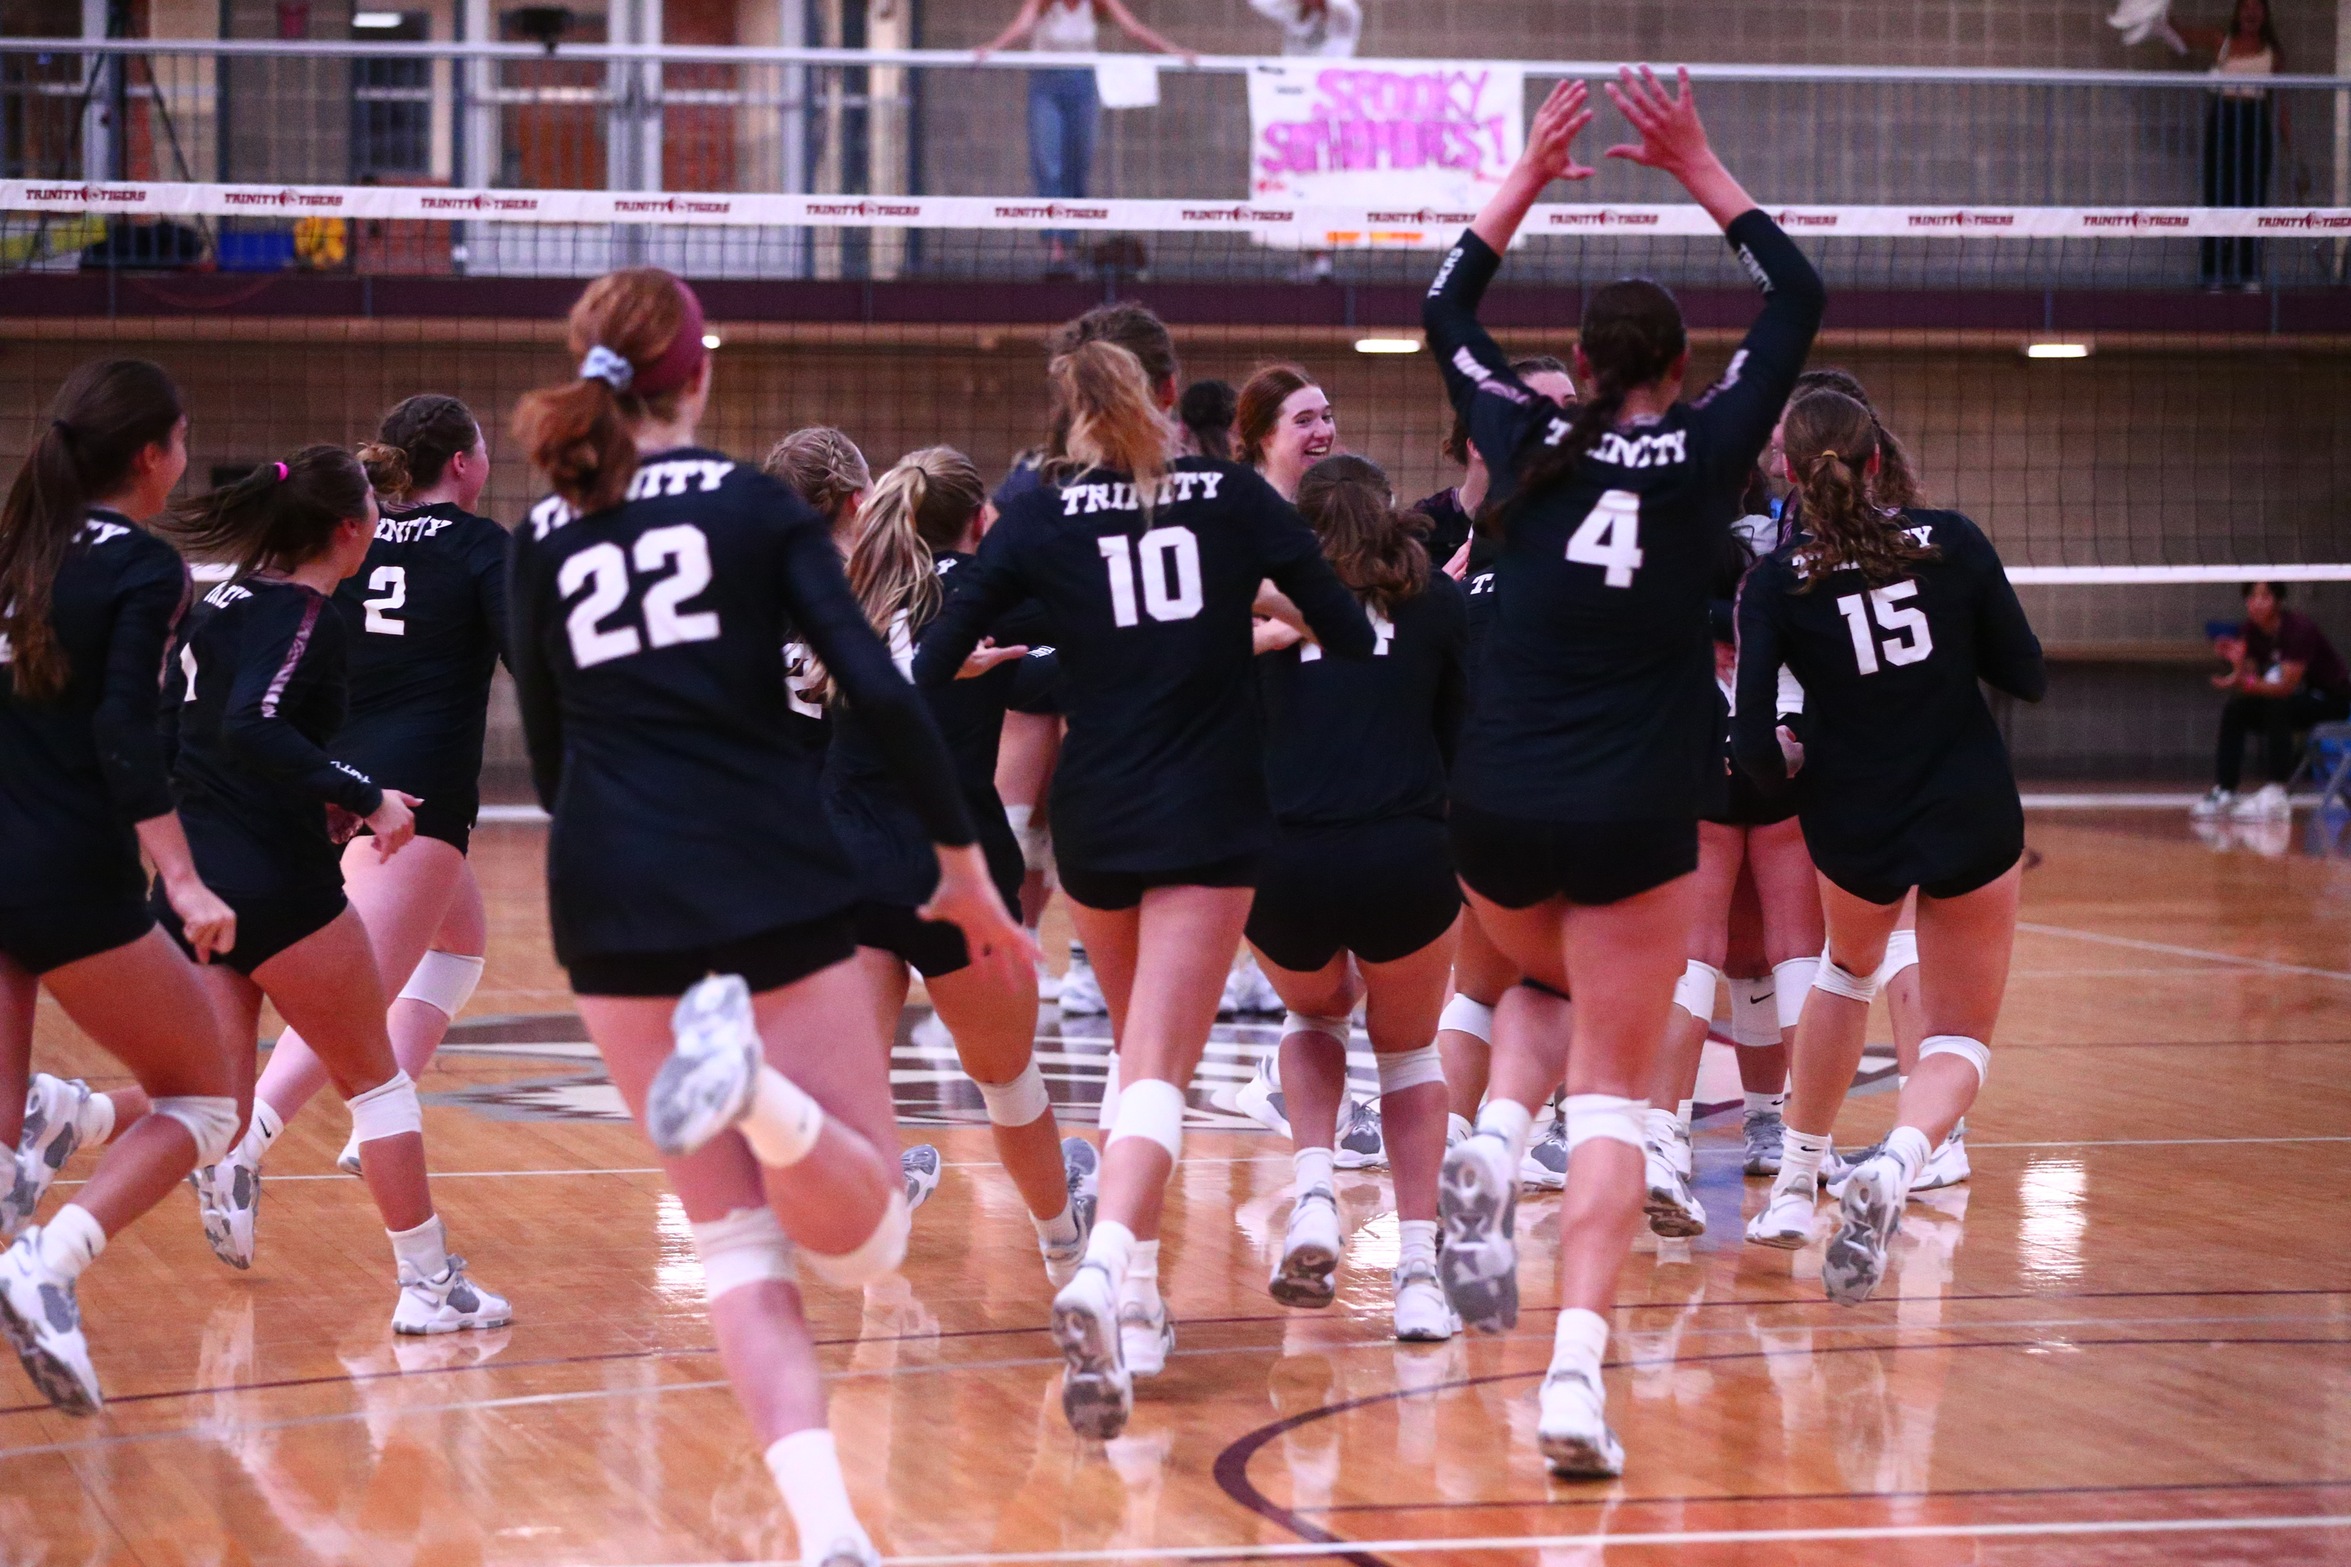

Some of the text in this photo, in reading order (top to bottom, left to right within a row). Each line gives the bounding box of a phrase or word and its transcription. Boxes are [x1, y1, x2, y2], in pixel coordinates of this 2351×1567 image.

[25, 189, 146, 202] TRINITY TIGERS
[225, 193, 343, 206] TRINITY TIGERS
[421, 197, 537, 210] TRINITY TIGERS
[614, 201, 730, 213] TRINITY TIGERS
[806, 204, 919, 216] TRINITY TIGERS
[994, 207, 1108, 219] TRINITY TIGERS
[1182, 210, 1294, 221] TRINITY TIGERS
[1367, 213, 1418, 223] TRINITY
[1550, 214, 1658, 225] TRINITY TIGERS
[1798, 215, 1838, 225] TIGERS
[1908, 215, 2014, 226] TRINITY TIGERS
[2083, 216, 2189, 227] TRINITY TIGERS
[2257, 217, 2306, 228] TRINITY
[1543, 416, 1686, 468] TINITY
[1565, 489, 1643, 588] 4
[1097, 526, 1204, 628] 10
[362, 565, 406, 636] 2
[557, 523, 721, 670] 22
[1836, 579, 1934, 676] 15
